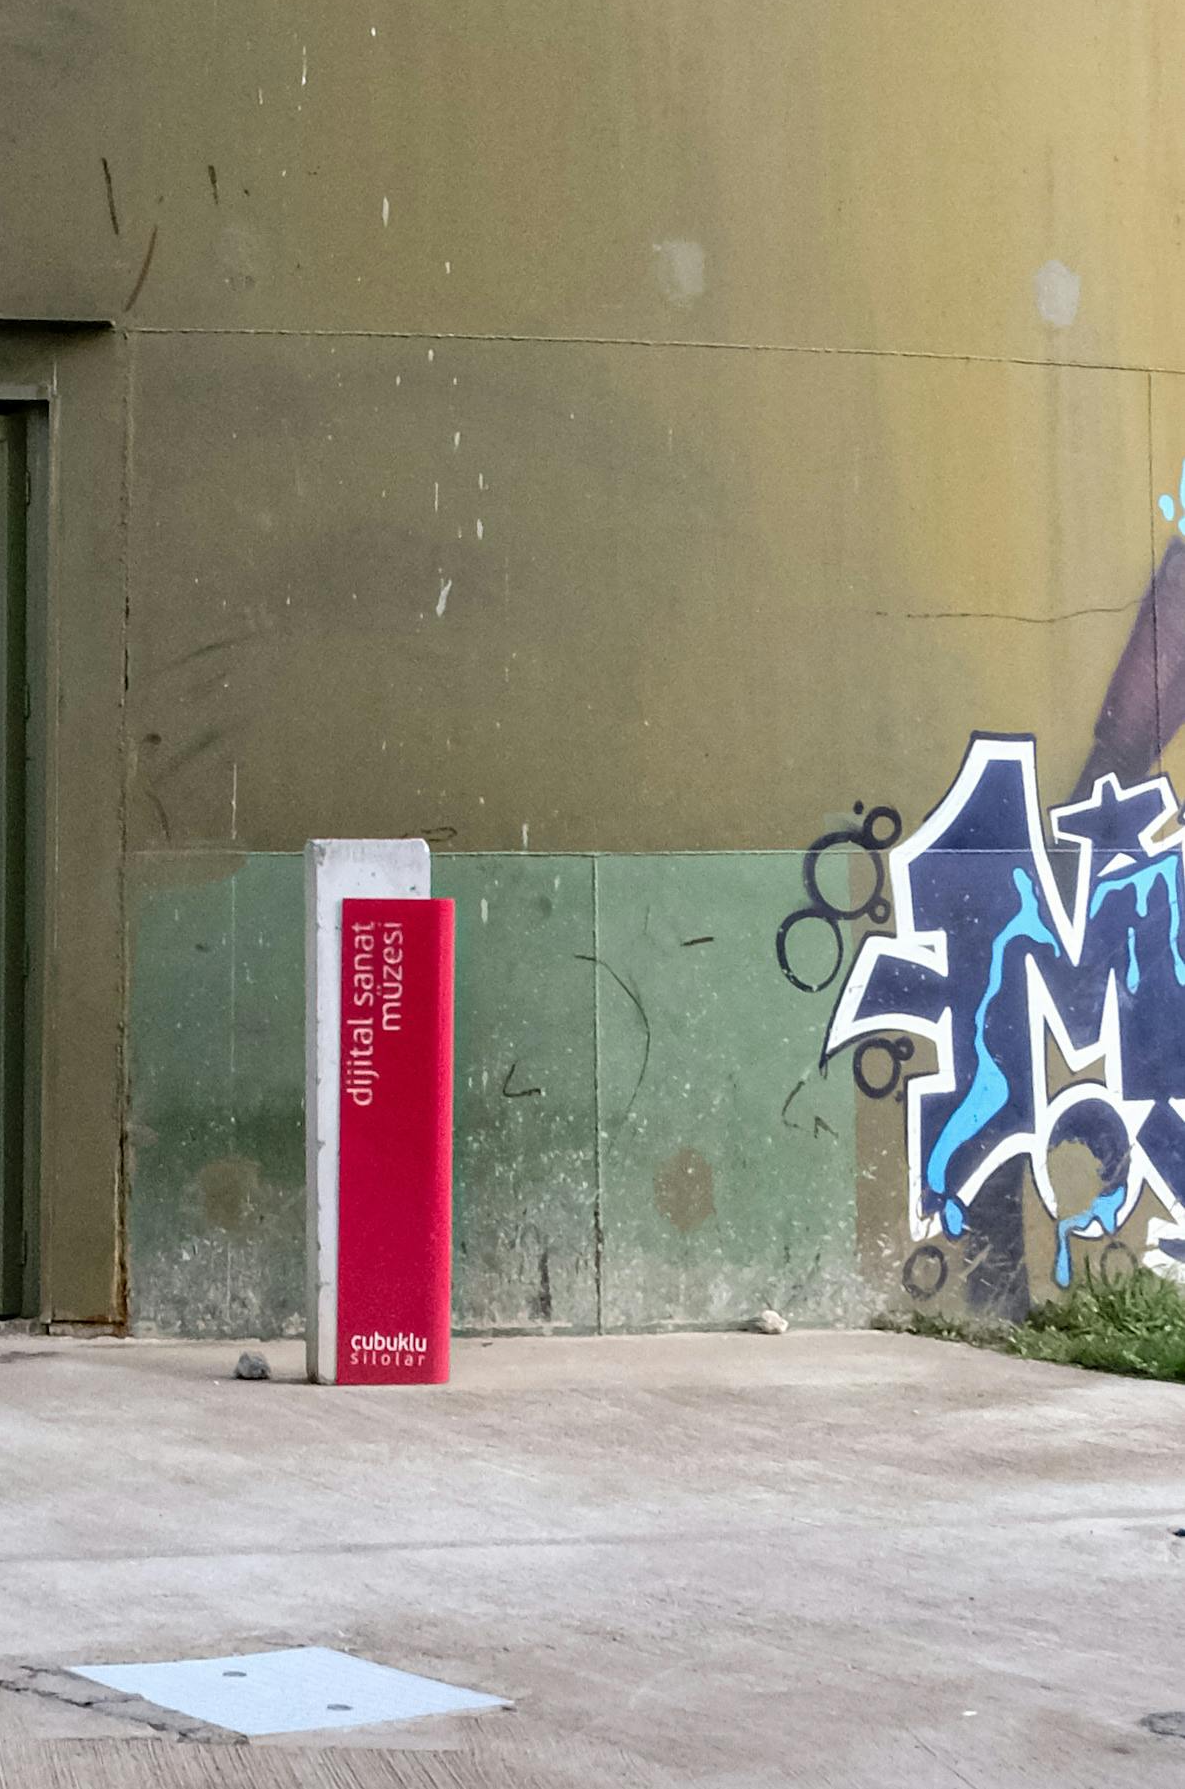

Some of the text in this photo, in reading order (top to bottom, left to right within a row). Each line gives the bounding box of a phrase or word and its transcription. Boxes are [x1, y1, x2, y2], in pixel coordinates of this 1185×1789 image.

[346, 921, 380, 1106] dijital sanat
[376, 922, 404, 1031] müzesi
[350, 1351, 426, 1367] silolar
